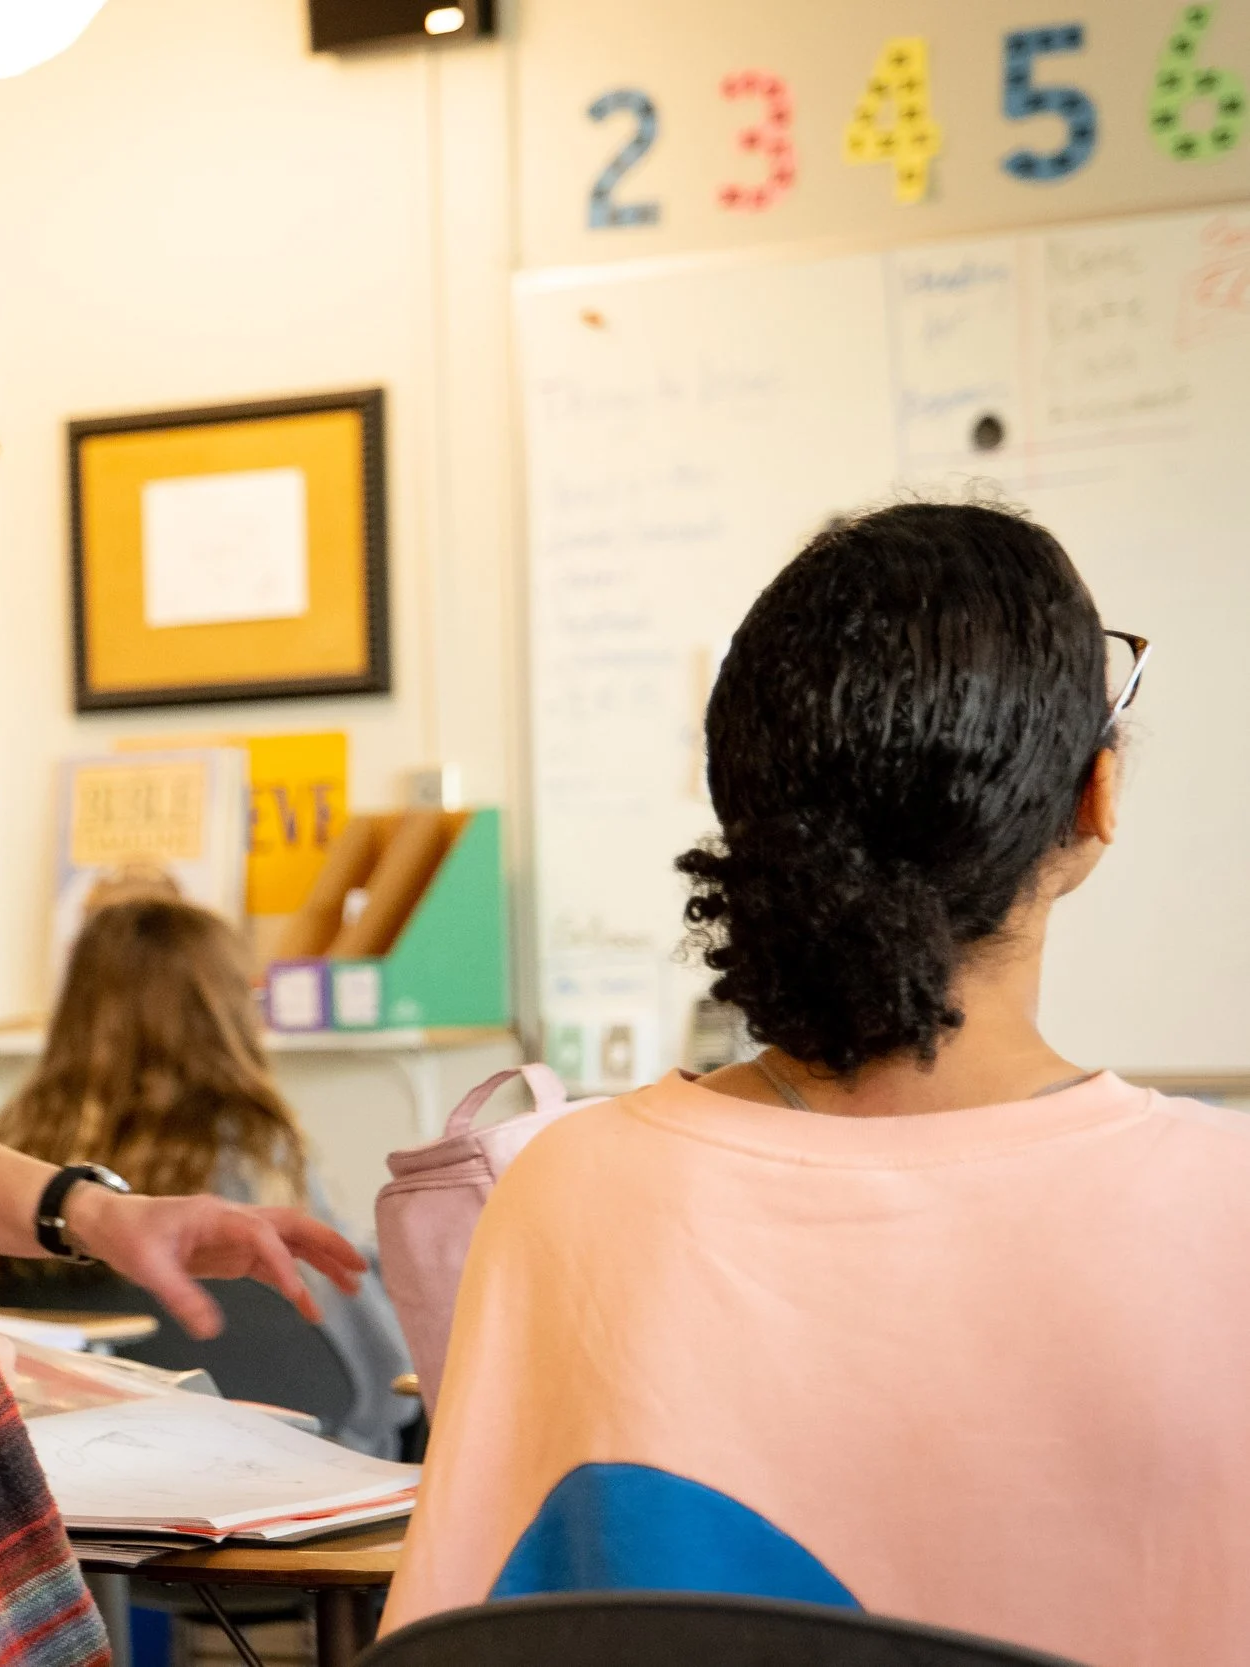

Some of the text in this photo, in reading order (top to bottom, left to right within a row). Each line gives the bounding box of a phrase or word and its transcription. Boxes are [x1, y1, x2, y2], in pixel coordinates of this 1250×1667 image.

[586, 2, 1247, 228] 2 3 4 5 6
